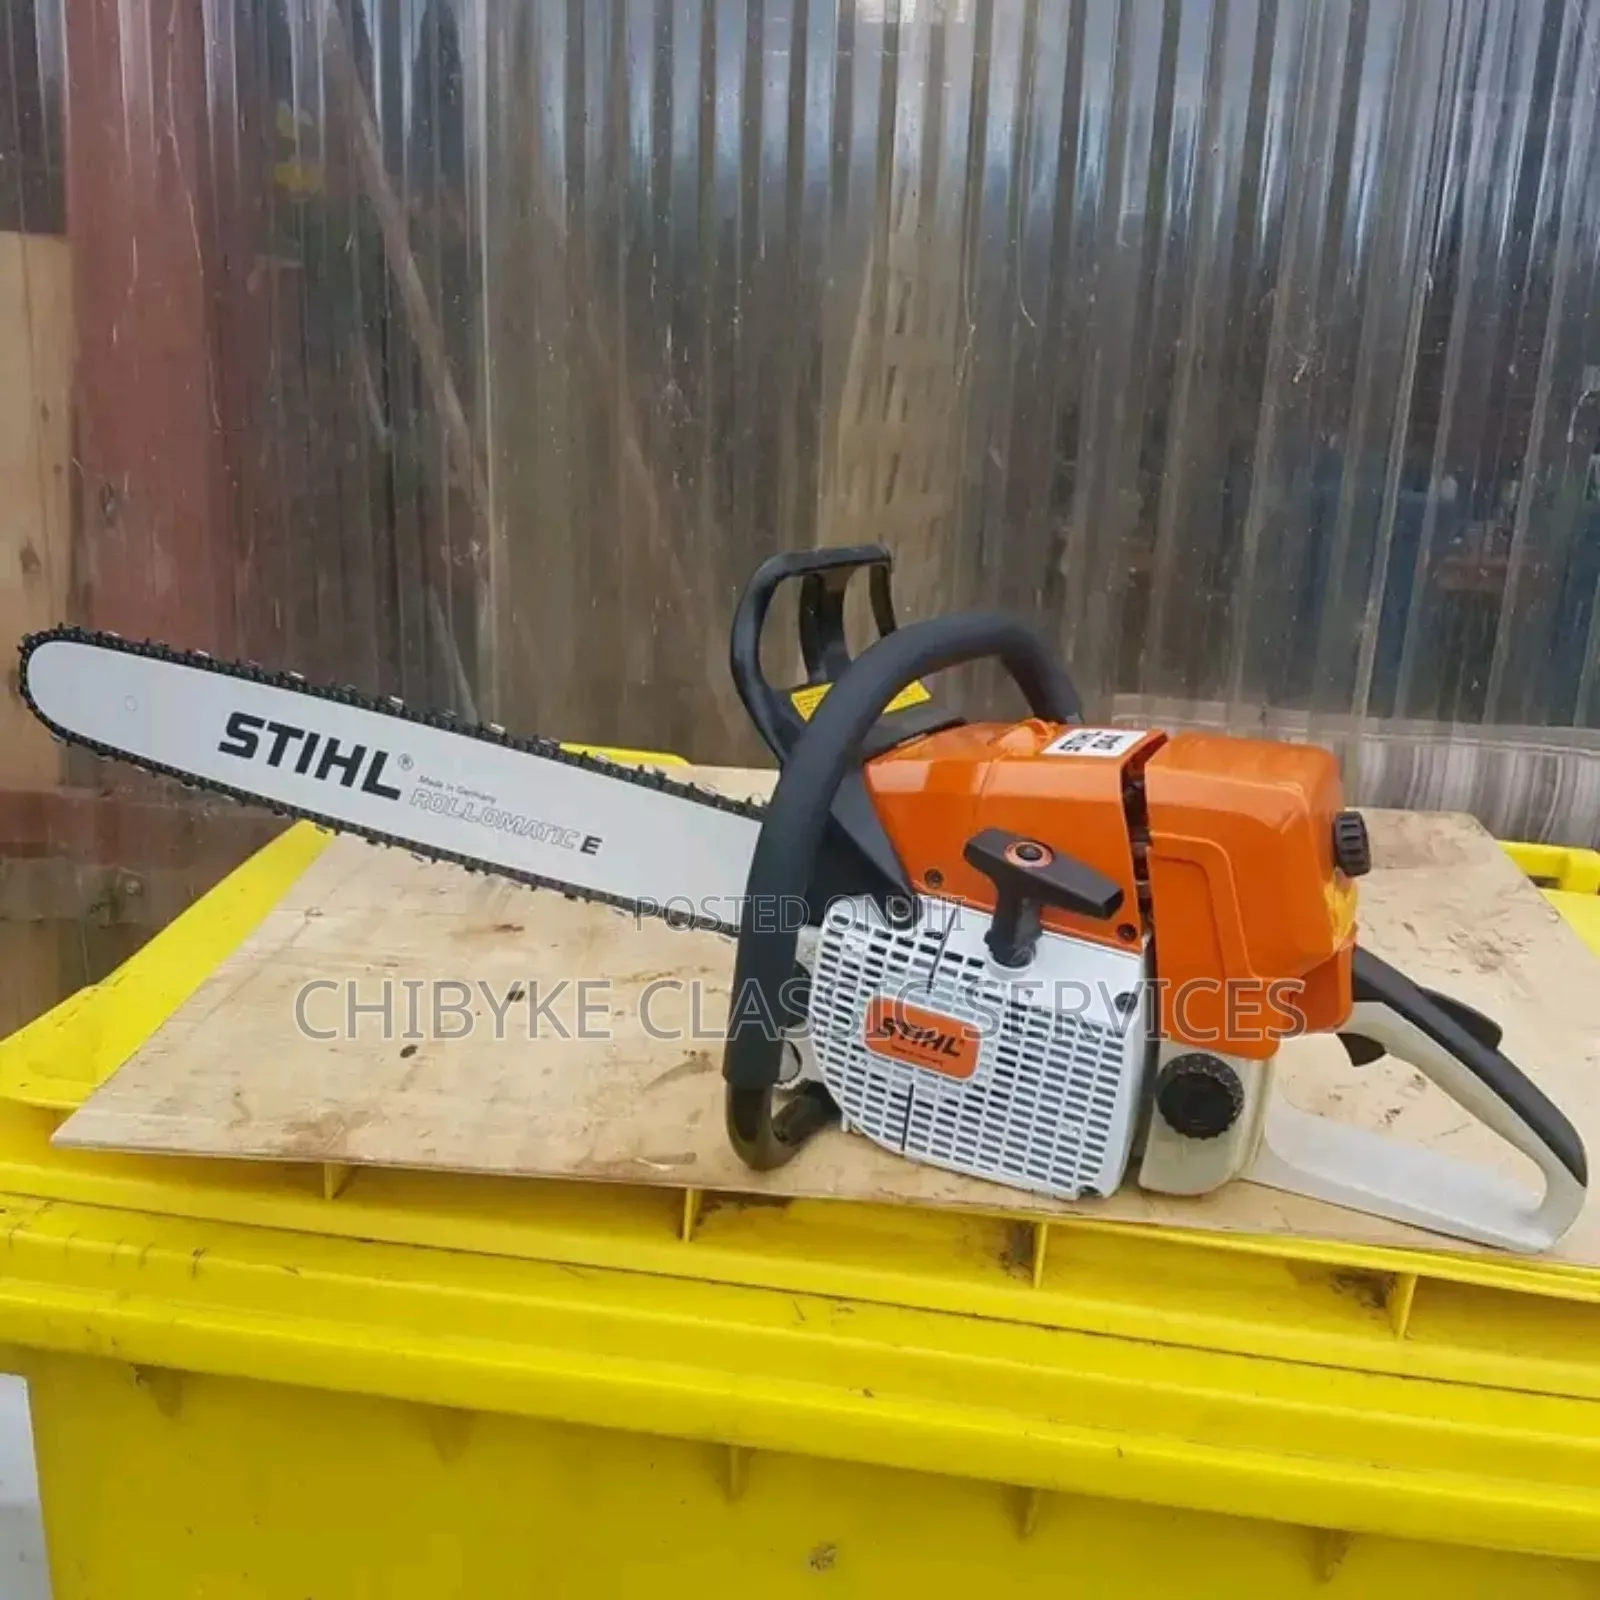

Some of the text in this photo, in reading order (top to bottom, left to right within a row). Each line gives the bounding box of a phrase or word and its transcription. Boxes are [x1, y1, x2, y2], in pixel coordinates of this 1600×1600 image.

[218, 711, 401, 801] STIHL
[410, 788, 602, 855] ROLLOMATIC E
[878, 1016, 961, 1057] STIHL
